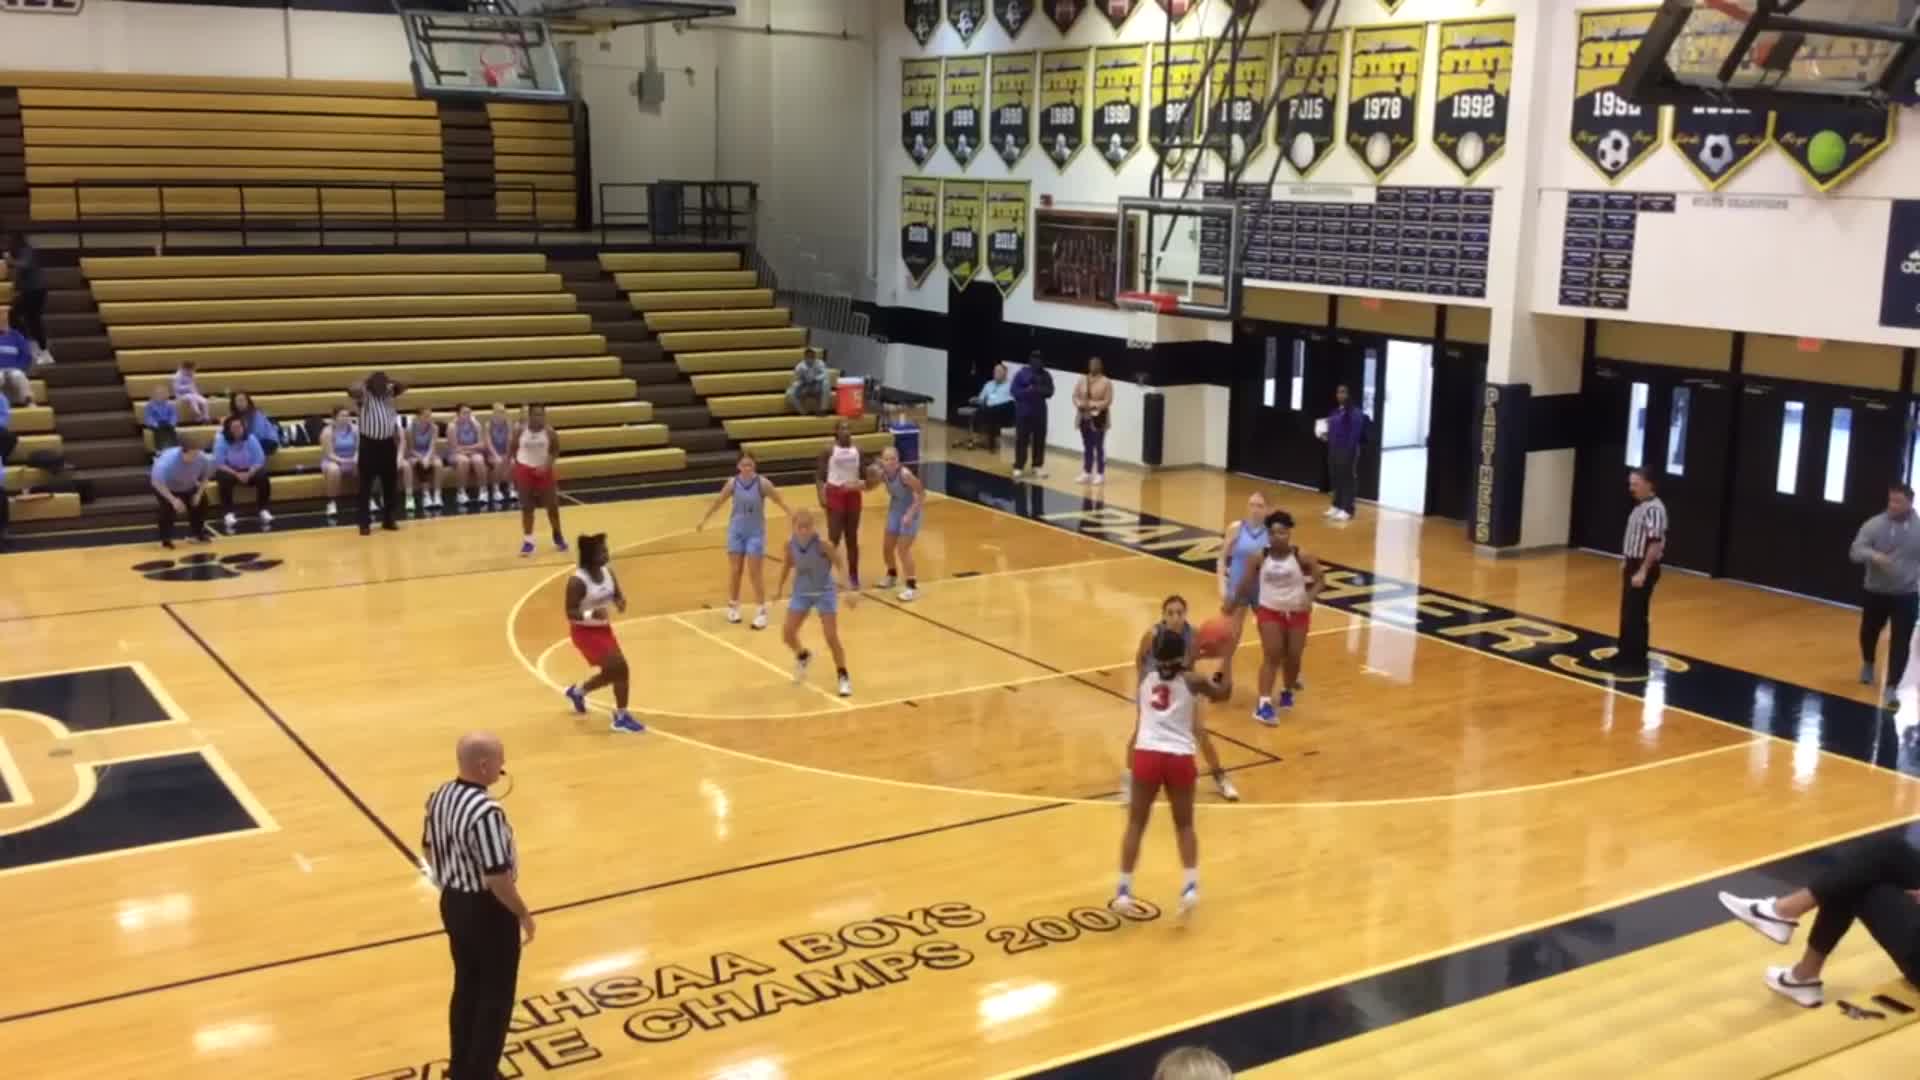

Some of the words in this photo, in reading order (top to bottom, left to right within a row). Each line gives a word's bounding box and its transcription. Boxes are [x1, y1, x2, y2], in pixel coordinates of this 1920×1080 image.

[1363, 97, 1402, 120] 1978
[1452, 94, 1495, 118] 1992
[1151, 684, 1171, 712] 3
[779, 902, 986, 964] BOYS
[623, 940, 975, 1043] CHAMPS
[986, 898, 1161, 955] 2000
